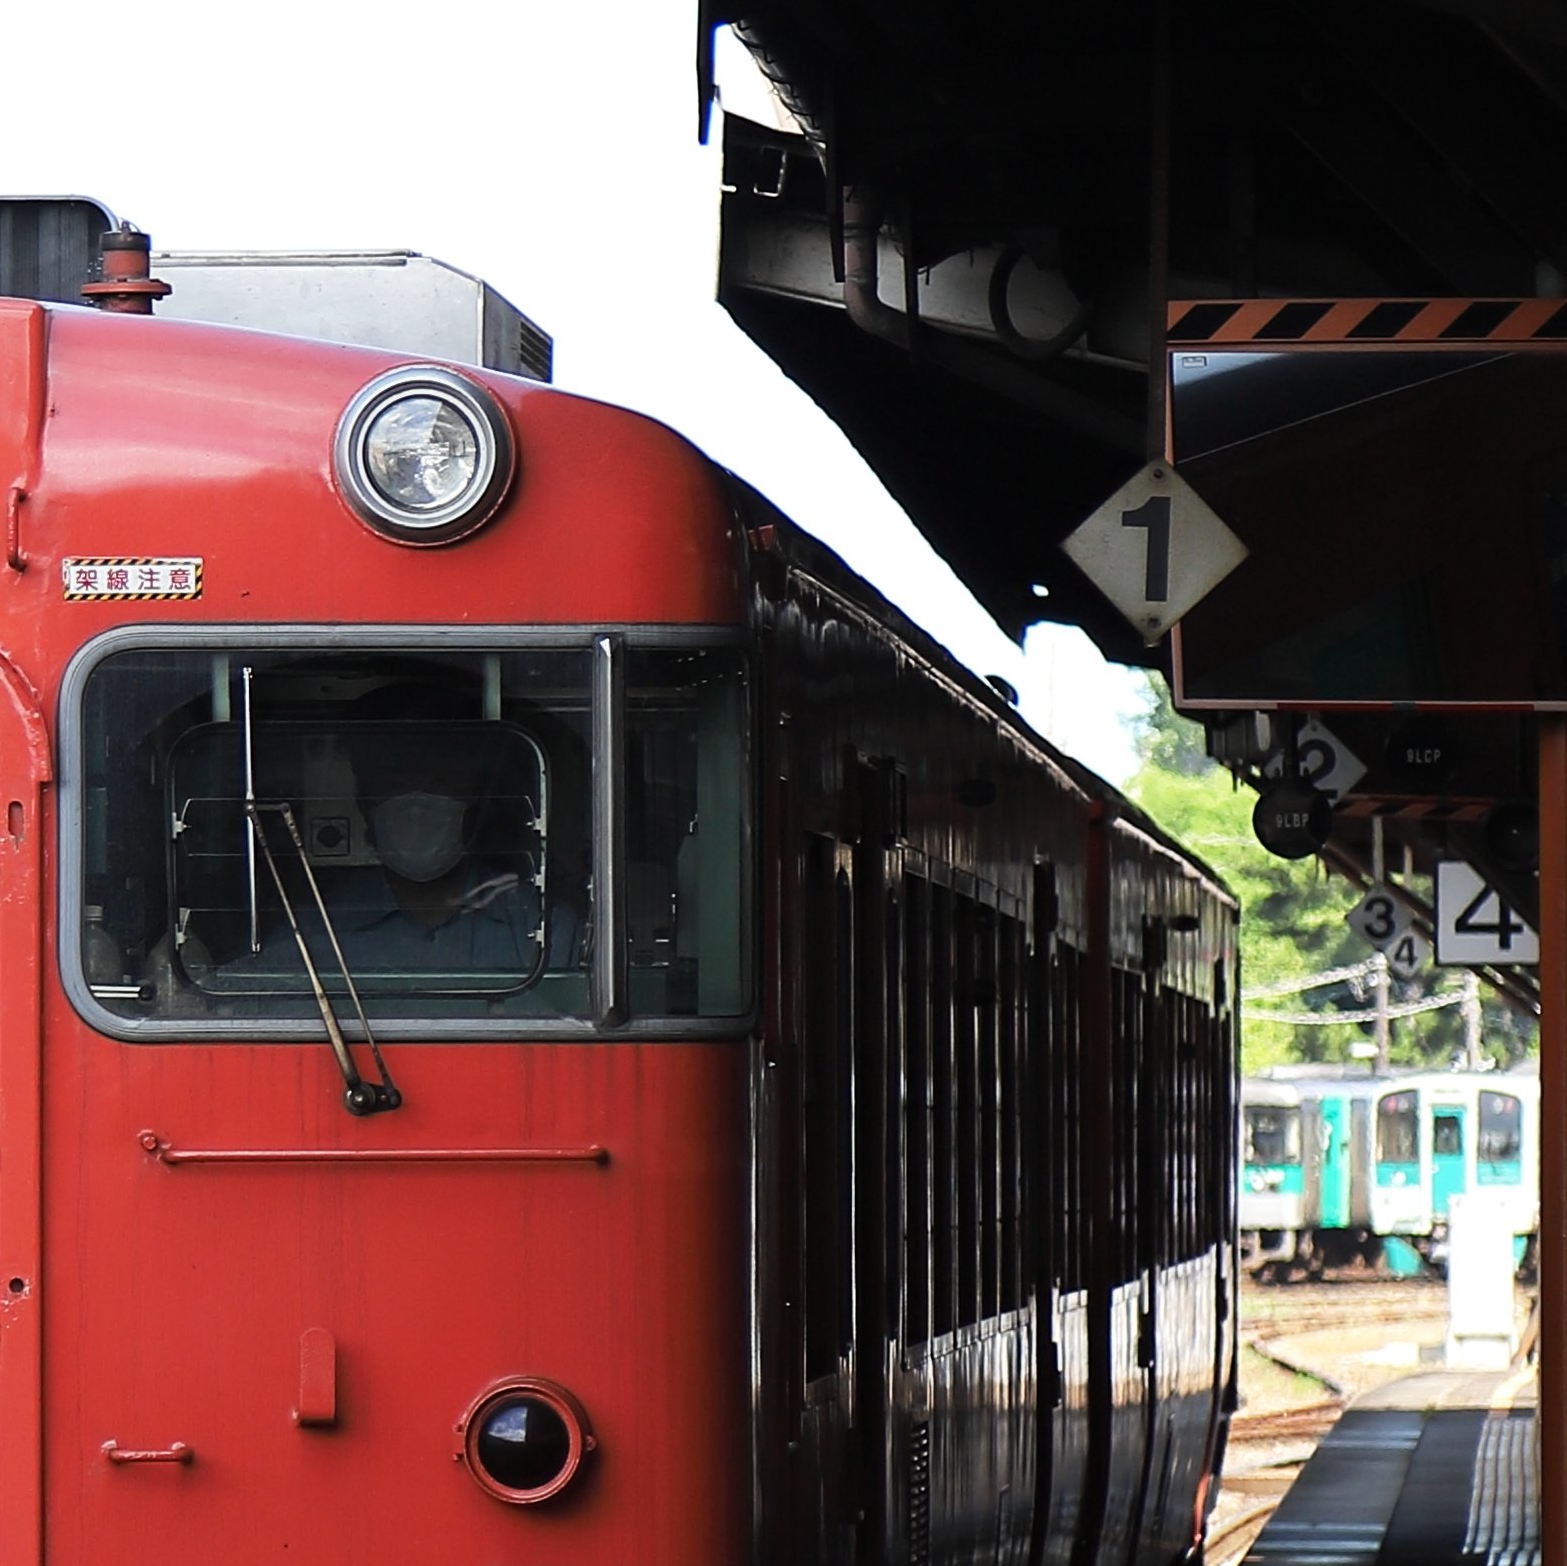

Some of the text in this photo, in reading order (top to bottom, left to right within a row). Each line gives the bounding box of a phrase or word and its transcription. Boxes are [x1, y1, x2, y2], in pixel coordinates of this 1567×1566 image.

[1121, 496, 1171, 602] 1
[75, 568, 193, 593] 架線注意
[1364, 896, 1396, 939] 3
[1454, 885, 1524, 950] 4
[1394, 936, 1417, 969] 4
